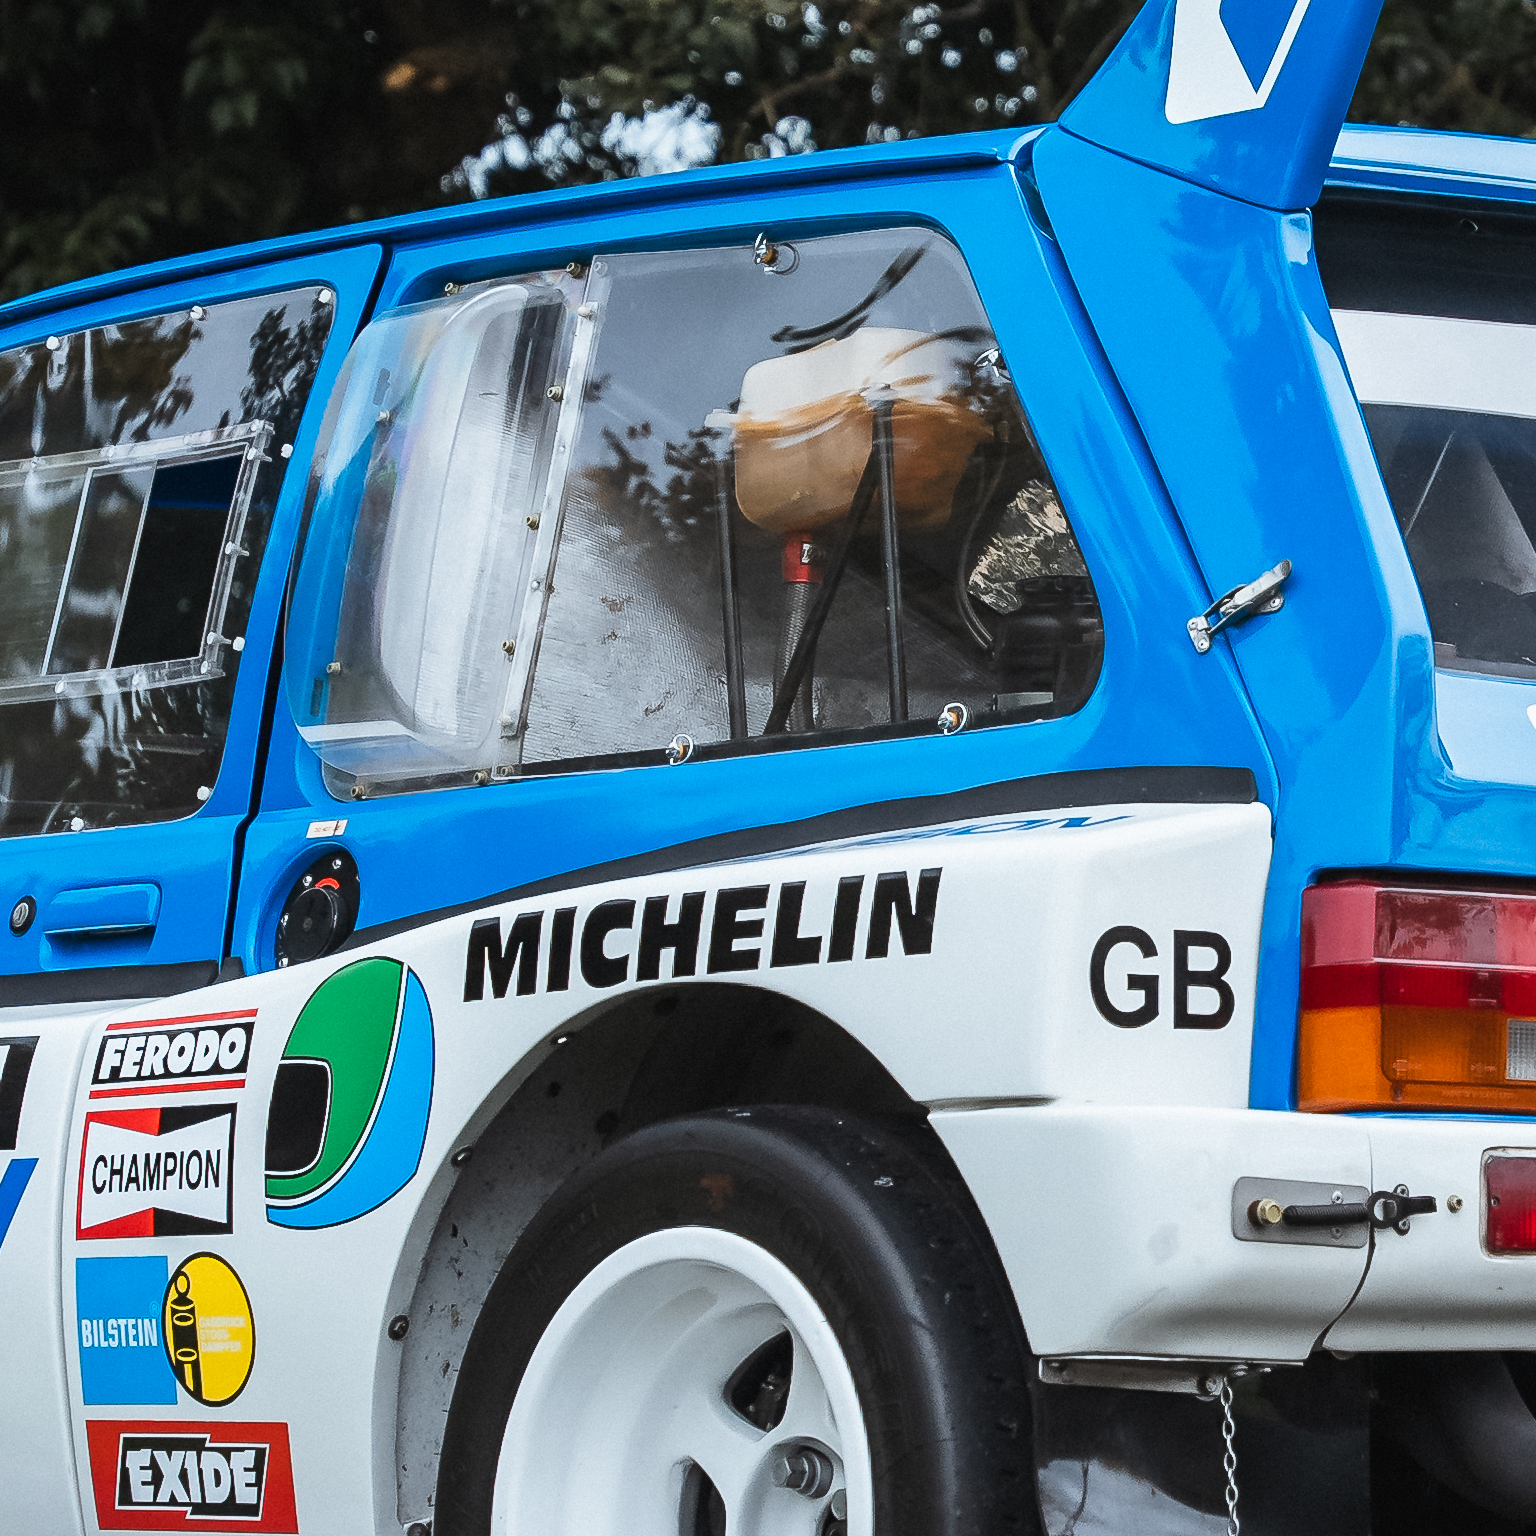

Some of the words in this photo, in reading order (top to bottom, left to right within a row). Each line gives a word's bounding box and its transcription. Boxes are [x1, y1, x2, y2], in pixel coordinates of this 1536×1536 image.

[463, 867, 942, 1003] MICHELIN
[1089, 925, 1236, 1030] GB
[98, 1027, 247, 1080] FERODO
[92, 1149, 221, 1194] CHAMPION
[81, 1319, 158, 1347] BILSTEIN
[126, 1449, 258, 1503] EXIDE
